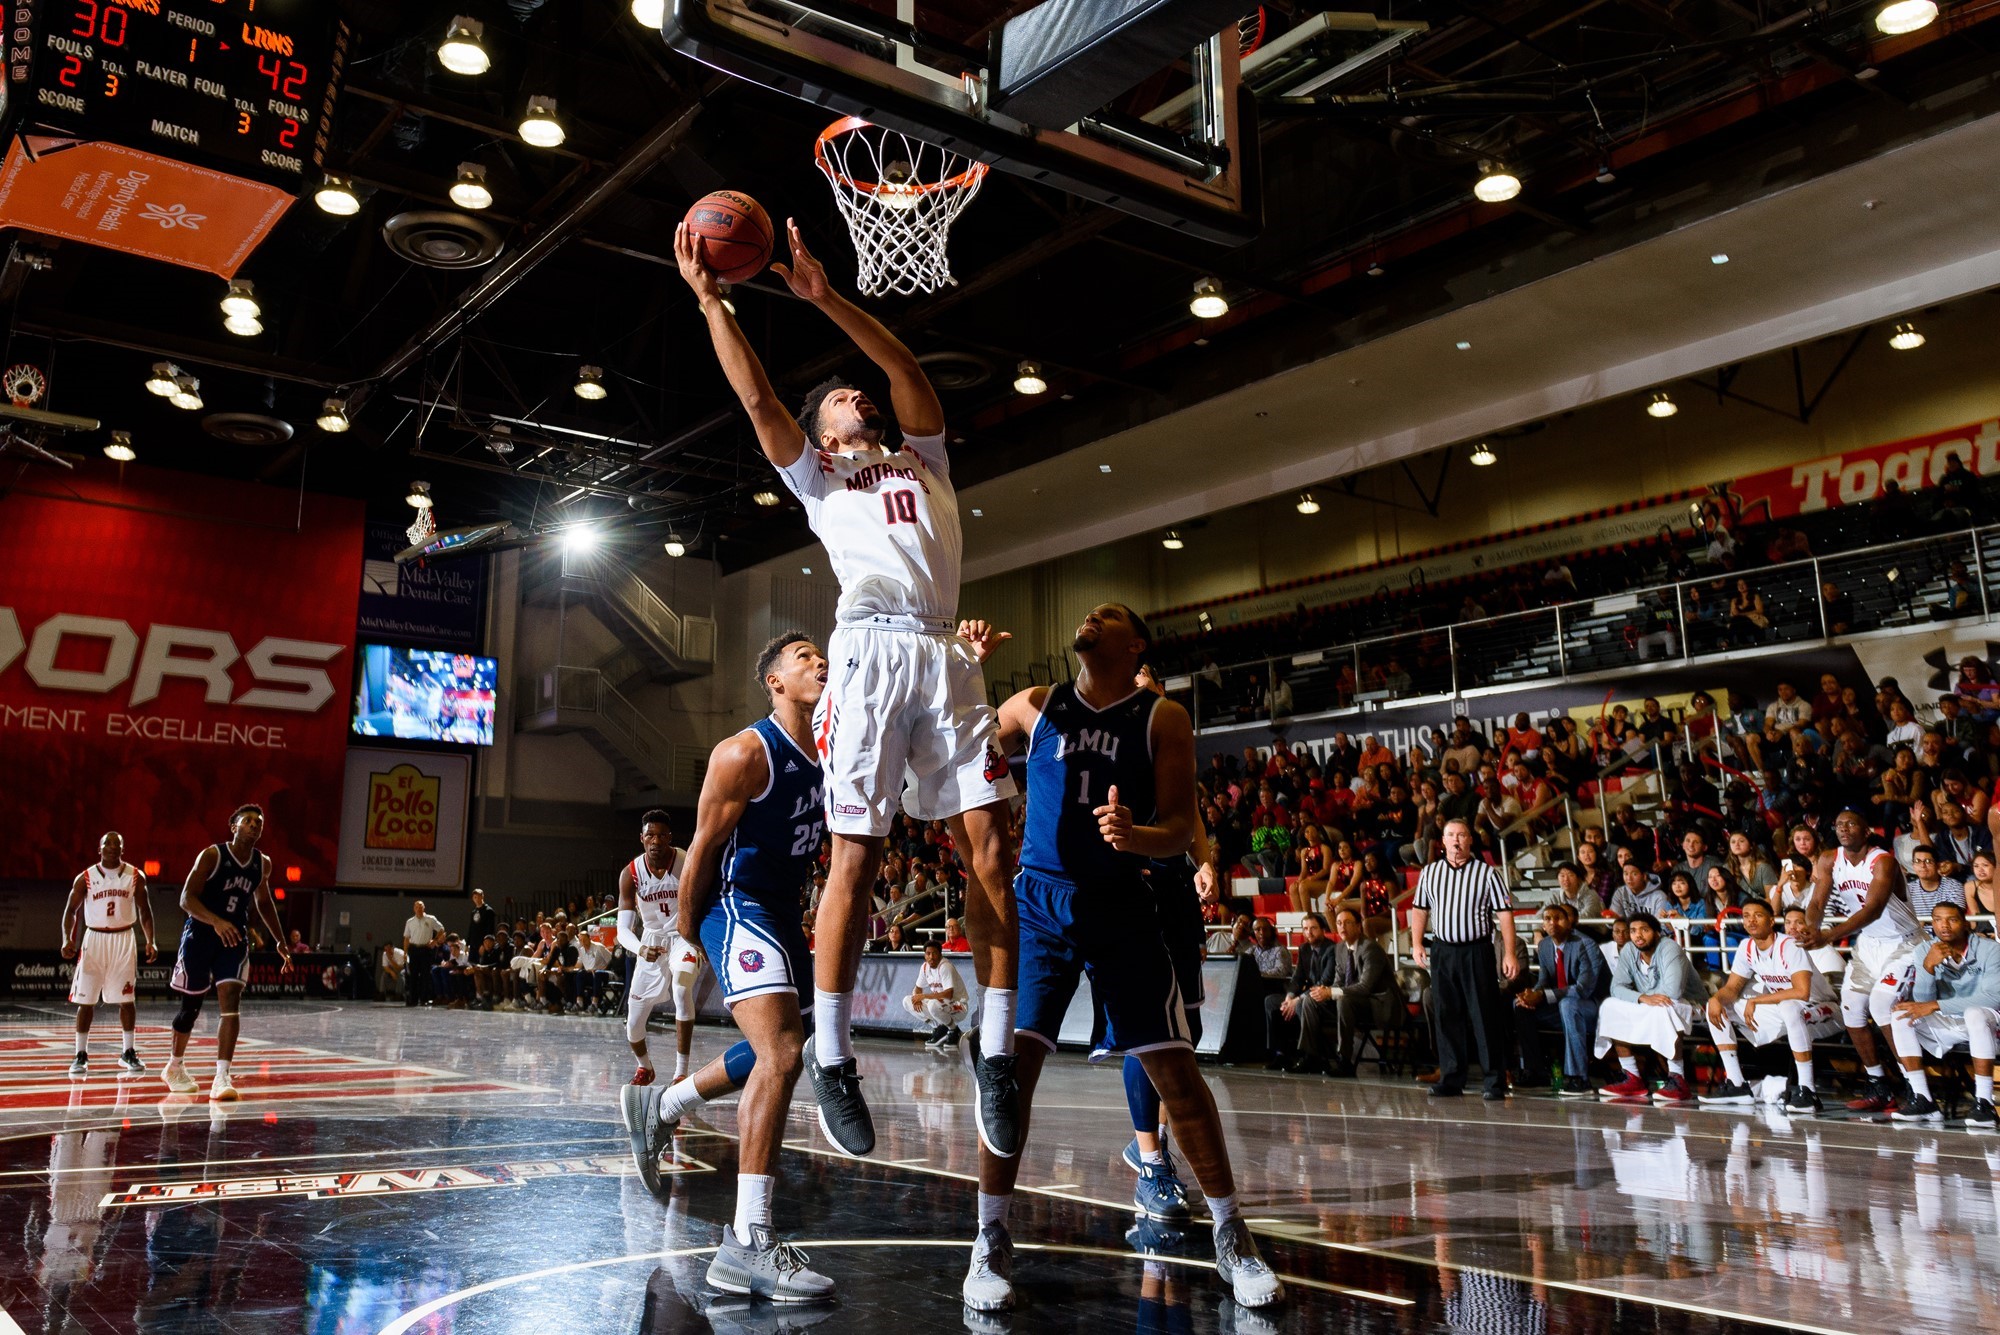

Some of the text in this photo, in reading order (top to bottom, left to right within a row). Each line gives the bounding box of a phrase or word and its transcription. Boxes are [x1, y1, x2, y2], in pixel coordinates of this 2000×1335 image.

[72, 0, 128, 46] 30
[168, 10, 215, 36] PERIOD
[47, 34, 95, 60] FOULS
[190, 38, 198, 62] 1
[242, 22, 294, 57] LIONS
[59, 56, 82, 87] 2
[101, 60, 127, 76] T.O.L.
[136, 60, 227, 100] PLAYER FOUL
[258, 55, 307, 100] 42
[104, 74, 119, 97] 3
[38, 88, 86, 115] SCORE
[234, 98, 259, 114] T.O.L.
[268, 99, 309, 124] FOULS
[151, 119, 199, 146] MATCH
[238, 112, 250, 134] 3
[280, 118, 299, 148] 2
[96, 143, 126, 155] CSUN
[128, 151, 143, 159] the
[157, 159, 189, 172] Partner
[192, 168, 221, 180] Health
[261, 150, 303, 175] SCORE
[61, 171, 91, 210] Medical Center
[76, 170, 114, 219] Northridge Hospital
[224, 176, 272, 193] Community
[96, 170, 150, 231] Dignity Health
[693, 208, 734, 229] NCAA
[845, 463, 931, 496] MATADOS
[882, 489, 918, 525] 10
[402, 565, 475, 592] Mid-Valley
[401, 583, 473, 606] Dental Care
[1455, 702, 1465, 715] 8
[0, 704, 287, 749] MENT. EXCELLENCE.
[1053, 727, 1120, 762] LMU
[1378, 724, 1435, 768] THIS
[398, 776, 415, 789] El
[1078, 770, 1090, 804] 1
[373, 783, 435, 816] Pollo
[789, 783, 826, 819] LM
[374, 810, 434, 837] Loco
[791, 819, 825, 856] 25
[362, 856, 437, 869] LOCATED ON CAMPUS
[92, 888, 130, 901] MATADORS
[223, 876, 252, 893] LMU
[641, 889, 679, 902] MATADOR
[106, 902, 116, 917] 2
[226, 896, 239, 912] 5
[659, 902, 671, 917] 4
[15, 962, 55, 978] Custom
